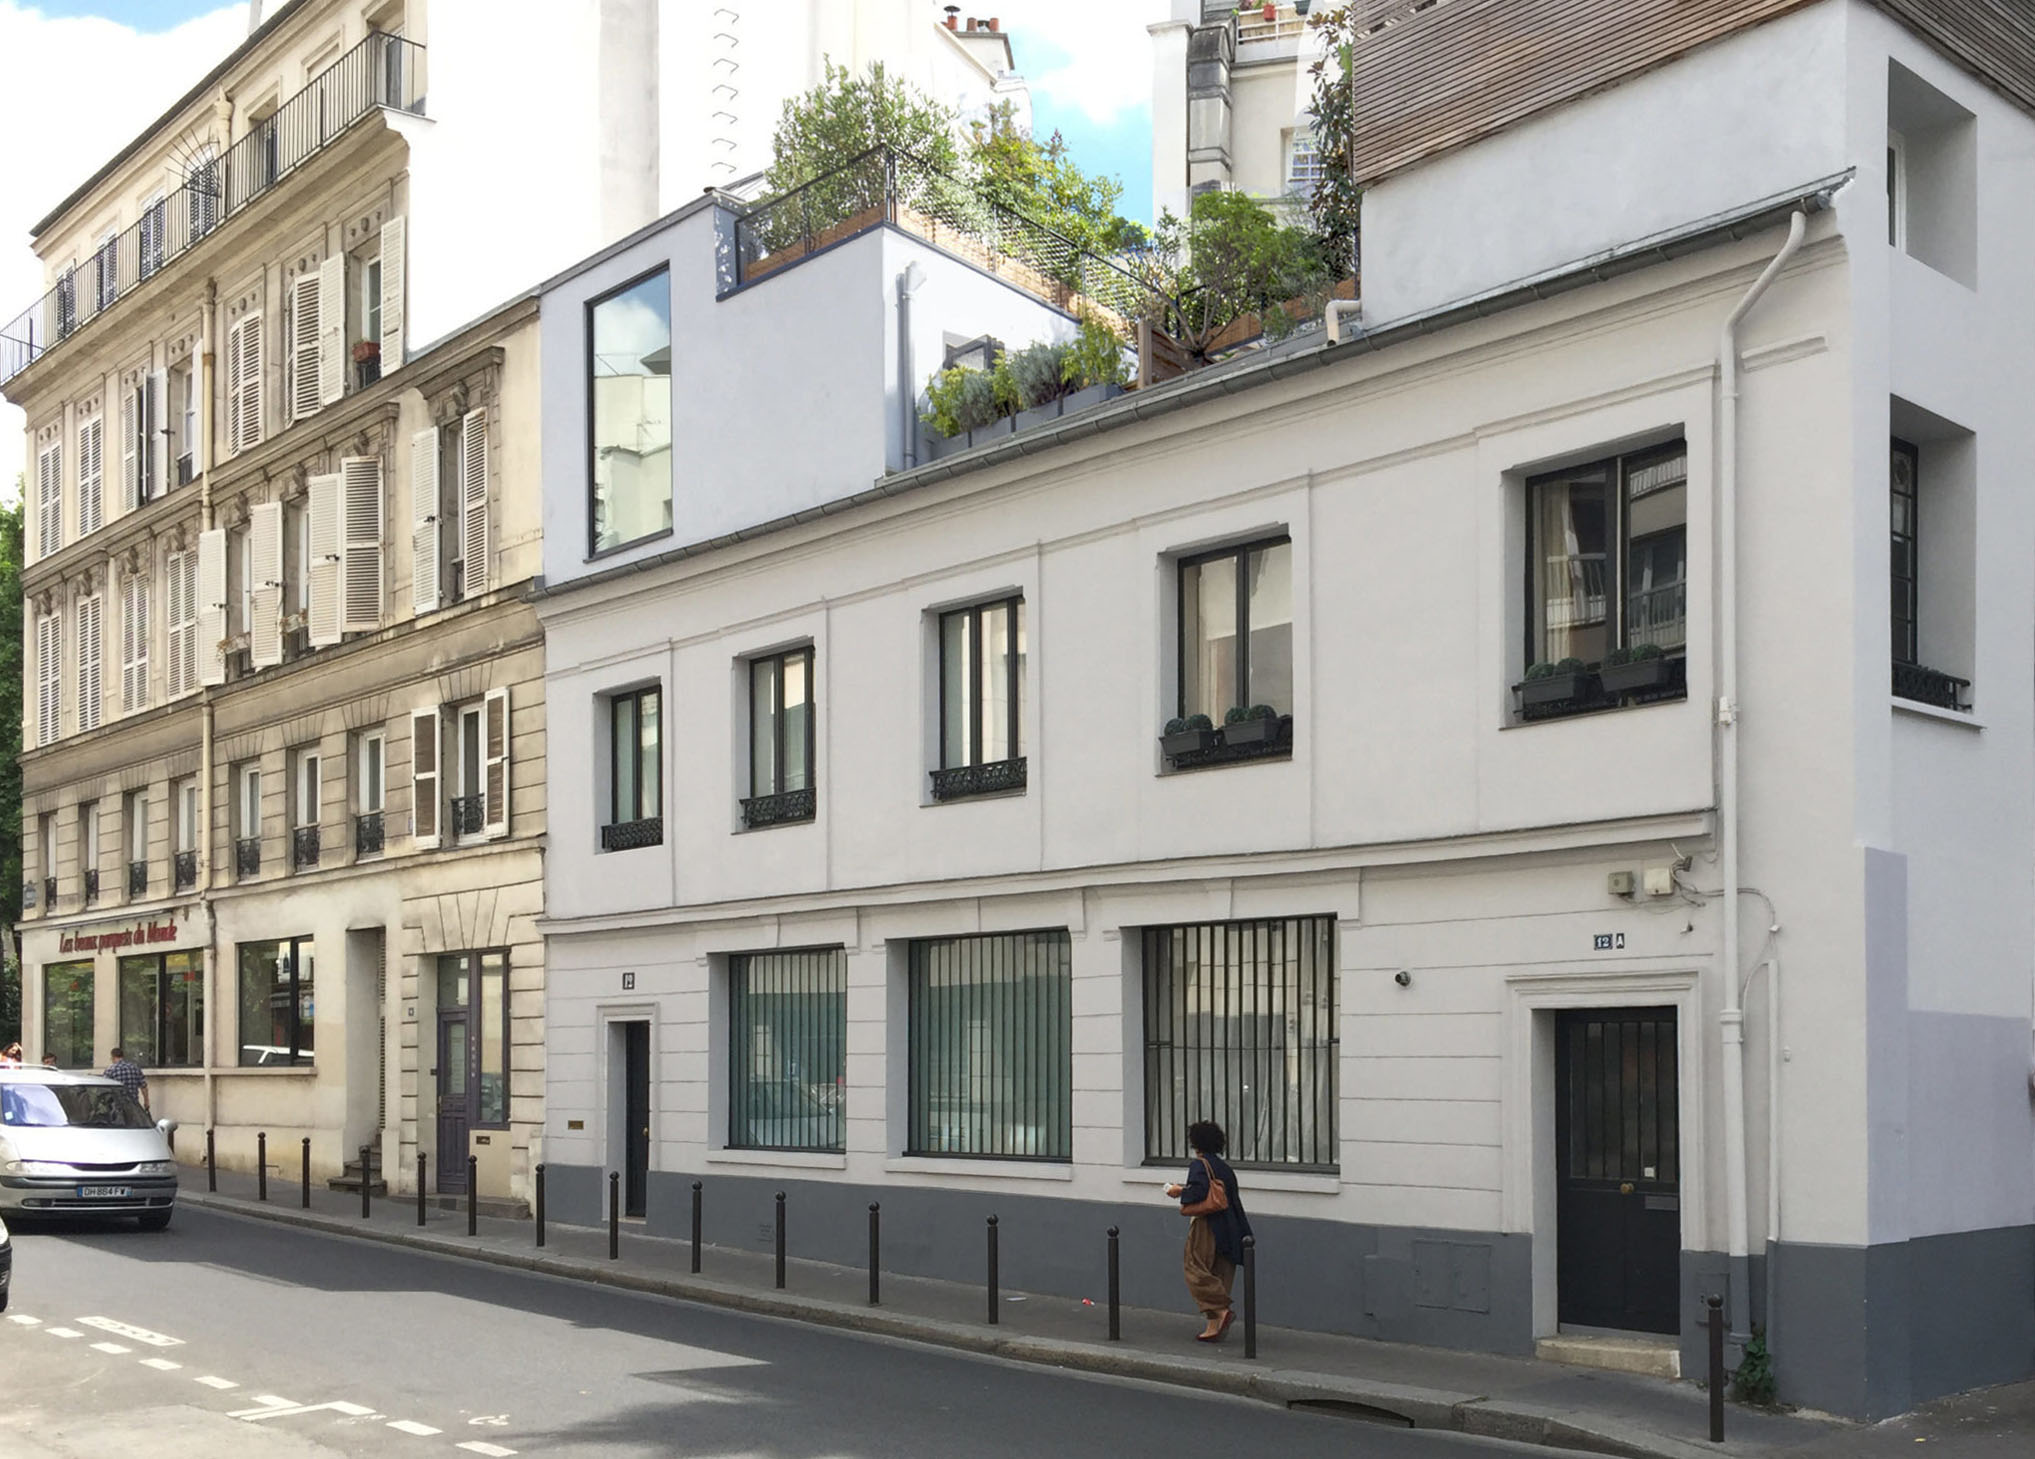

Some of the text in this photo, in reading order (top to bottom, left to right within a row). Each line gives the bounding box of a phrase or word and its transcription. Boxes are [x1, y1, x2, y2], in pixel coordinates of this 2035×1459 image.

[59, 933, 73, 953] Les
[1596, 935, 1624, 948] 12 A
